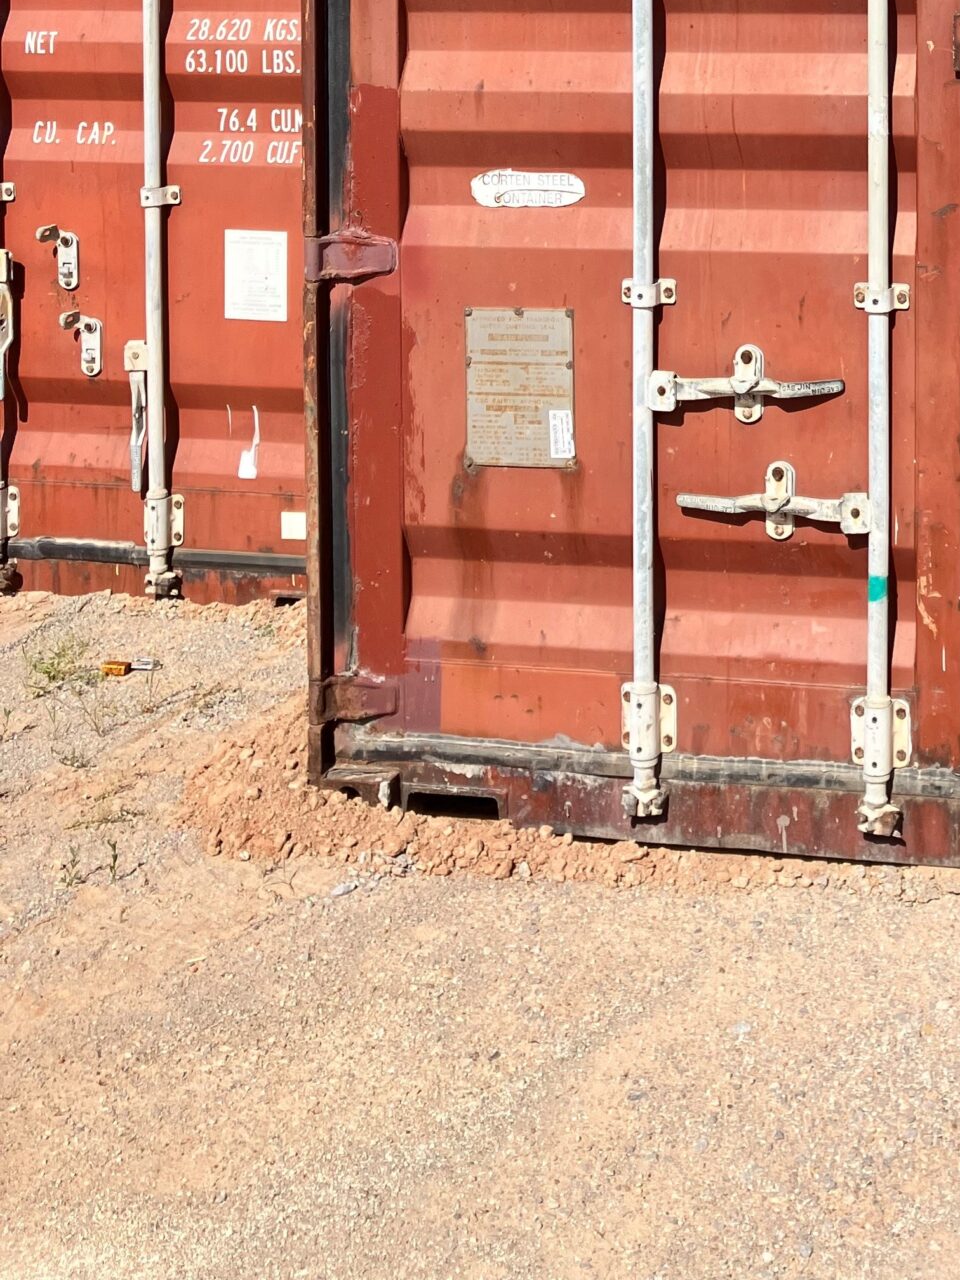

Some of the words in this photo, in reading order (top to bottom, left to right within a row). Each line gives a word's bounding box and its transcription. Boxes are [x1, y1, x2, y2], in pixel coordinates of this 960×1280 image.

[185, 17, 252, 41] 28,620
[24, 30, 59, 54] NET
[217, 107, 257, 132] 76.4
[32, 120, 61, 144] CU.
[75, 121, 116, 145] CAP.
[482, 174, 531, 186] CORTEN
[537, 174, 574, 186] STEEL
